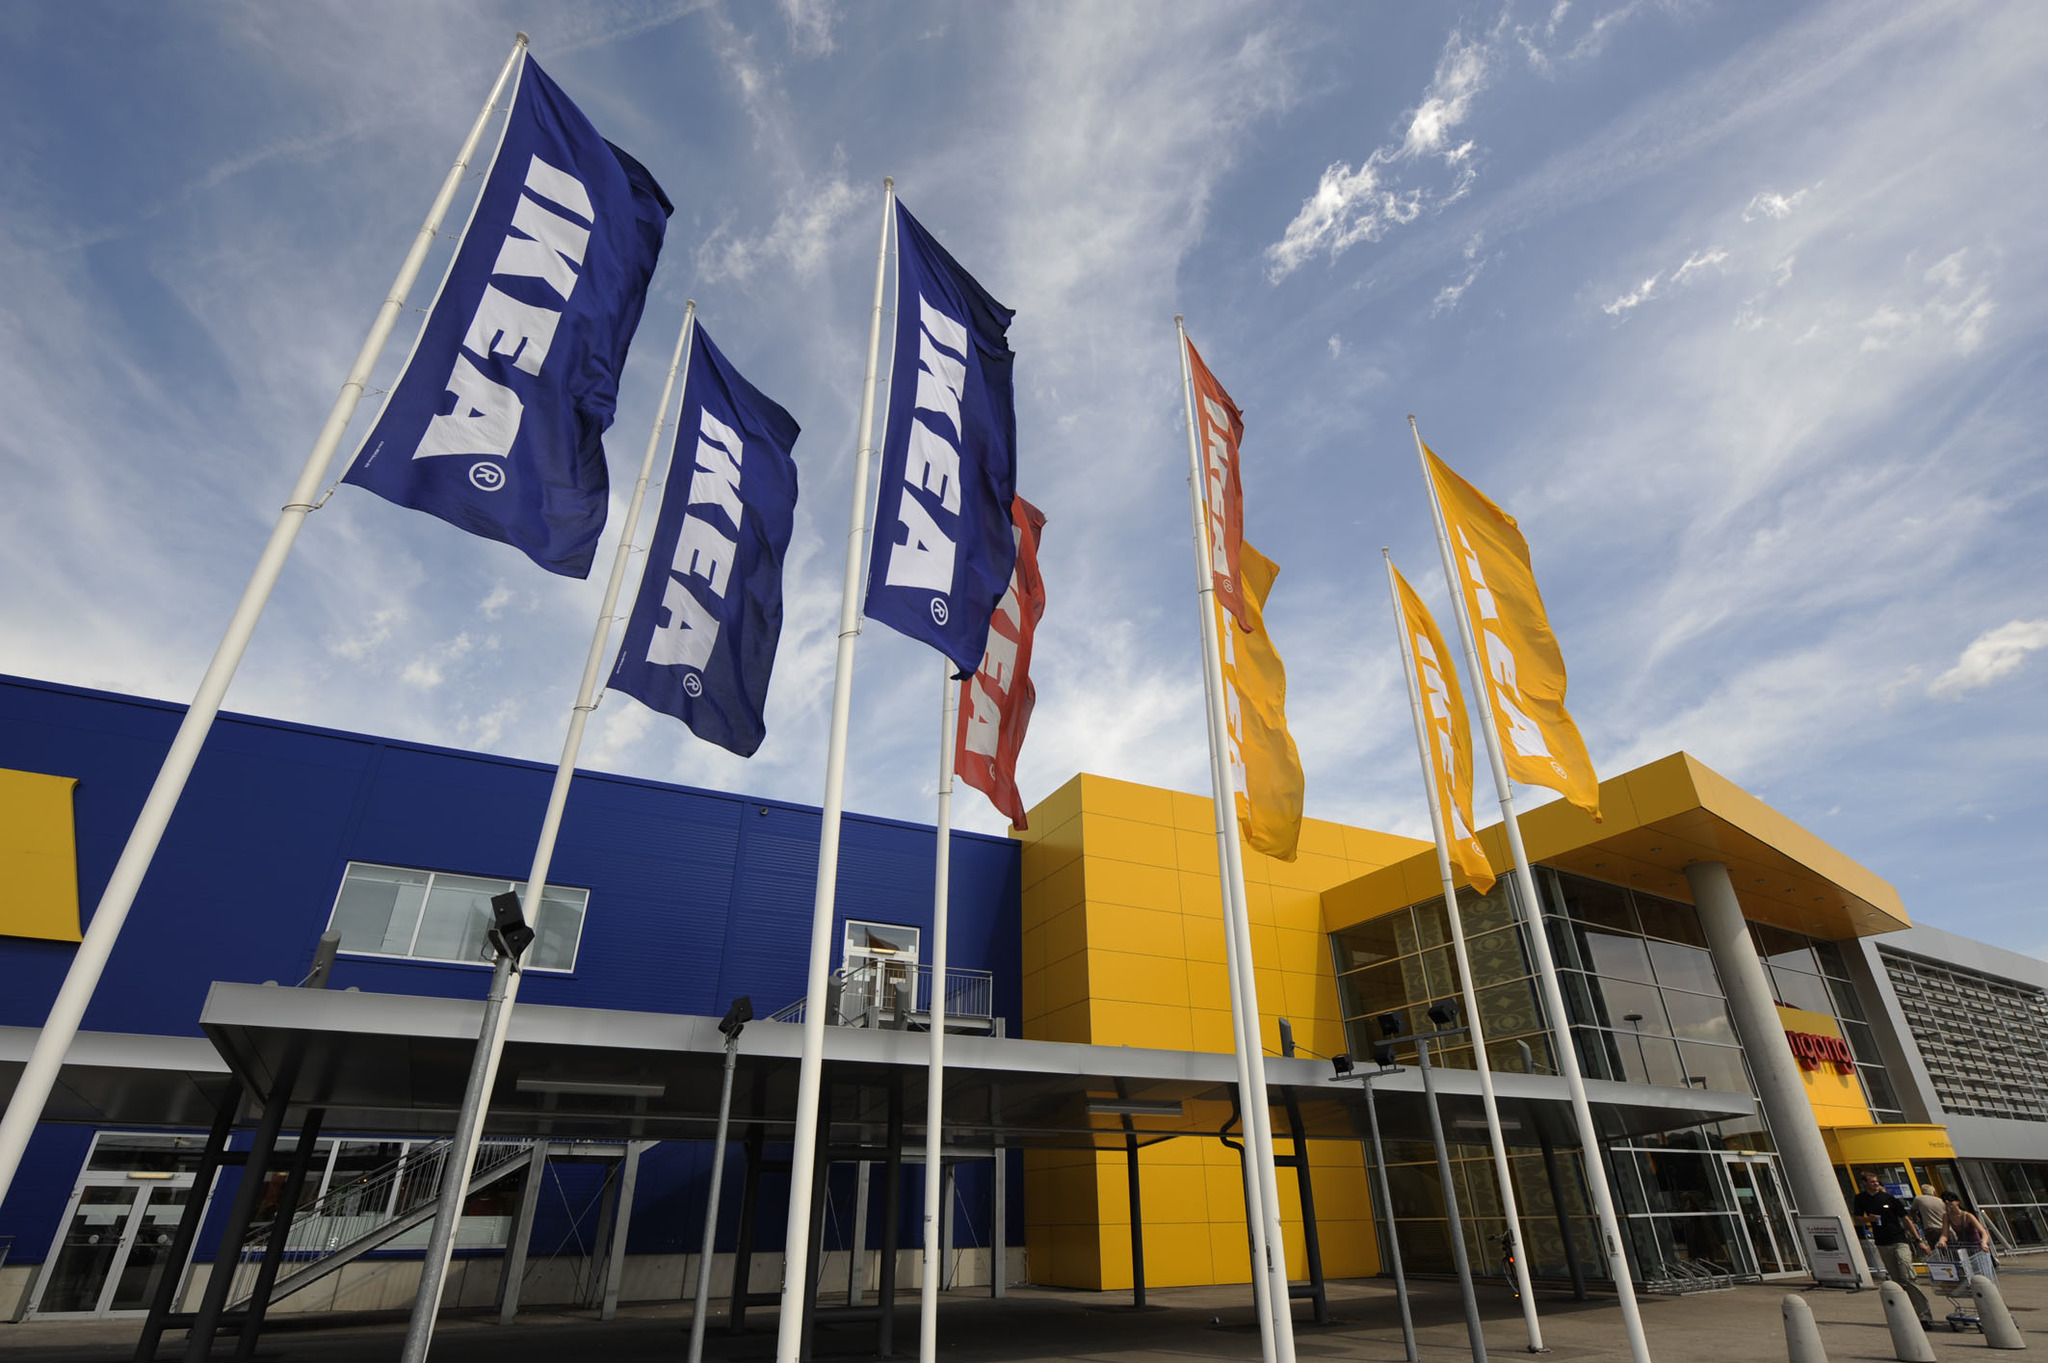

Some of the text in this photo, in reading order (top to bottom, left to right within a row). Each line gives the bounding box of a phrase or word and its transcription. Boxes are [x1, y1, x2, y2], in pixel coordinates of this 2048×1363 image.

[413, 153, 595, 459] IKEA
[646, 405, 744, 673] IKEA
[886, 292, 967, 596] IKEA
[1203, 393, 1231, 578] IKEA
[1785, 1030, 1855, 1075] ngang
